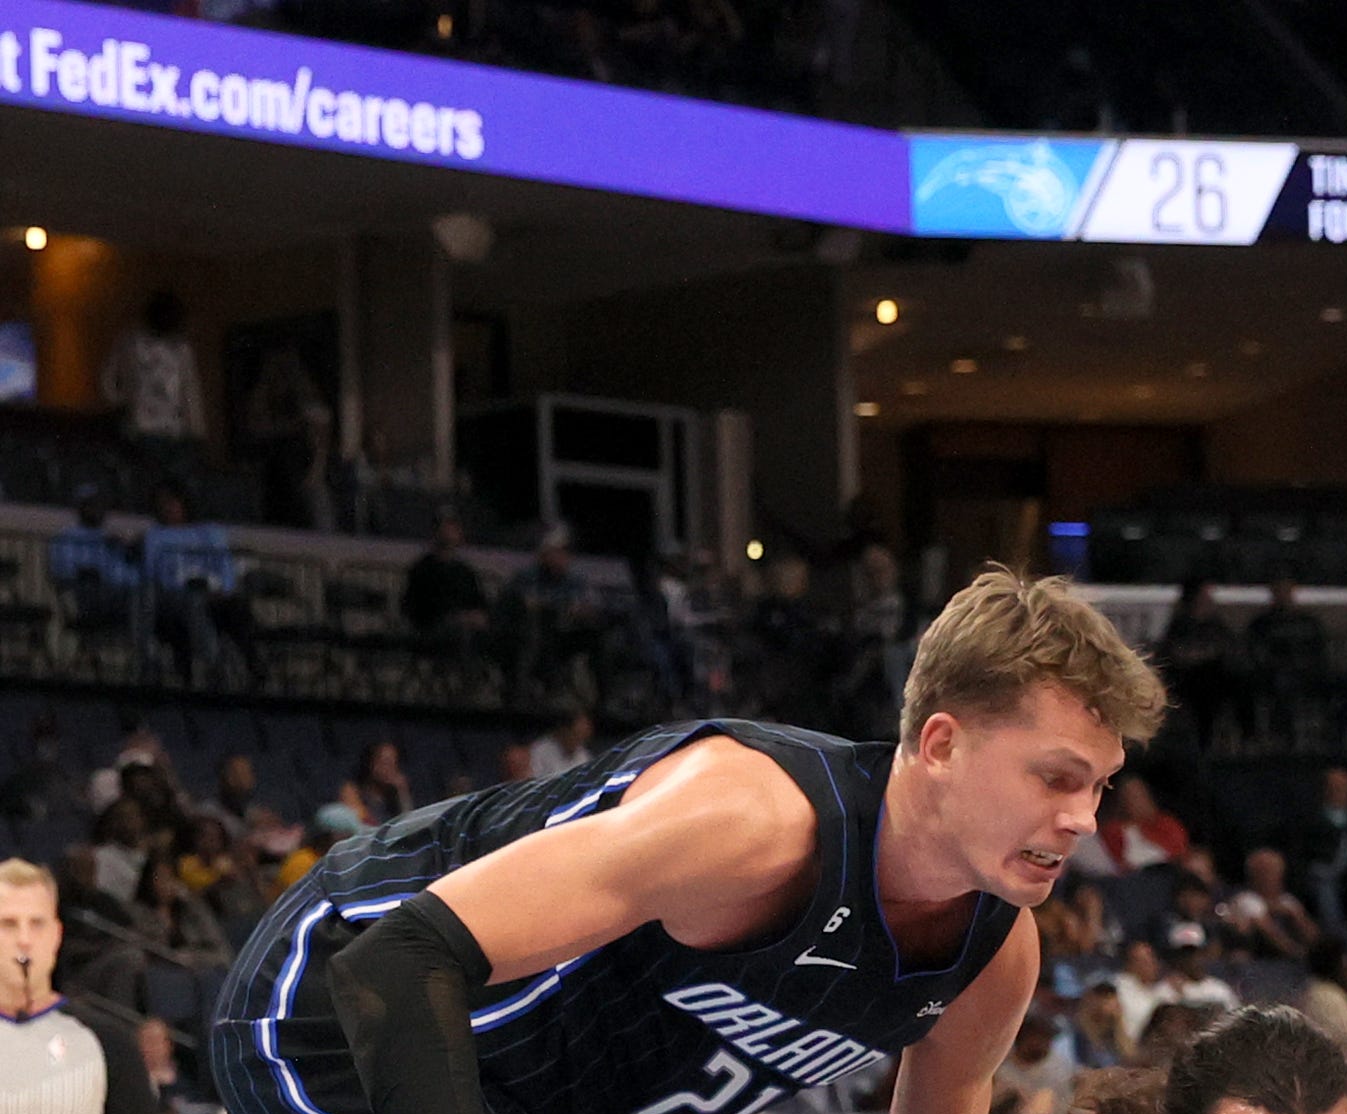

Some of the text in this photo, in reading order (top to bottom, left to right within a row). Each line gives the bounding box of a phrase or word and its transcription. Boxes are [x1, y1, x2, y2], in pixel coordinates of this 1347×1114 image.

[29, 27, 485, 160] FedEx.com/careers
[1150, 150, 1229, 235] 26
[822, 906, 851, 932] 6
